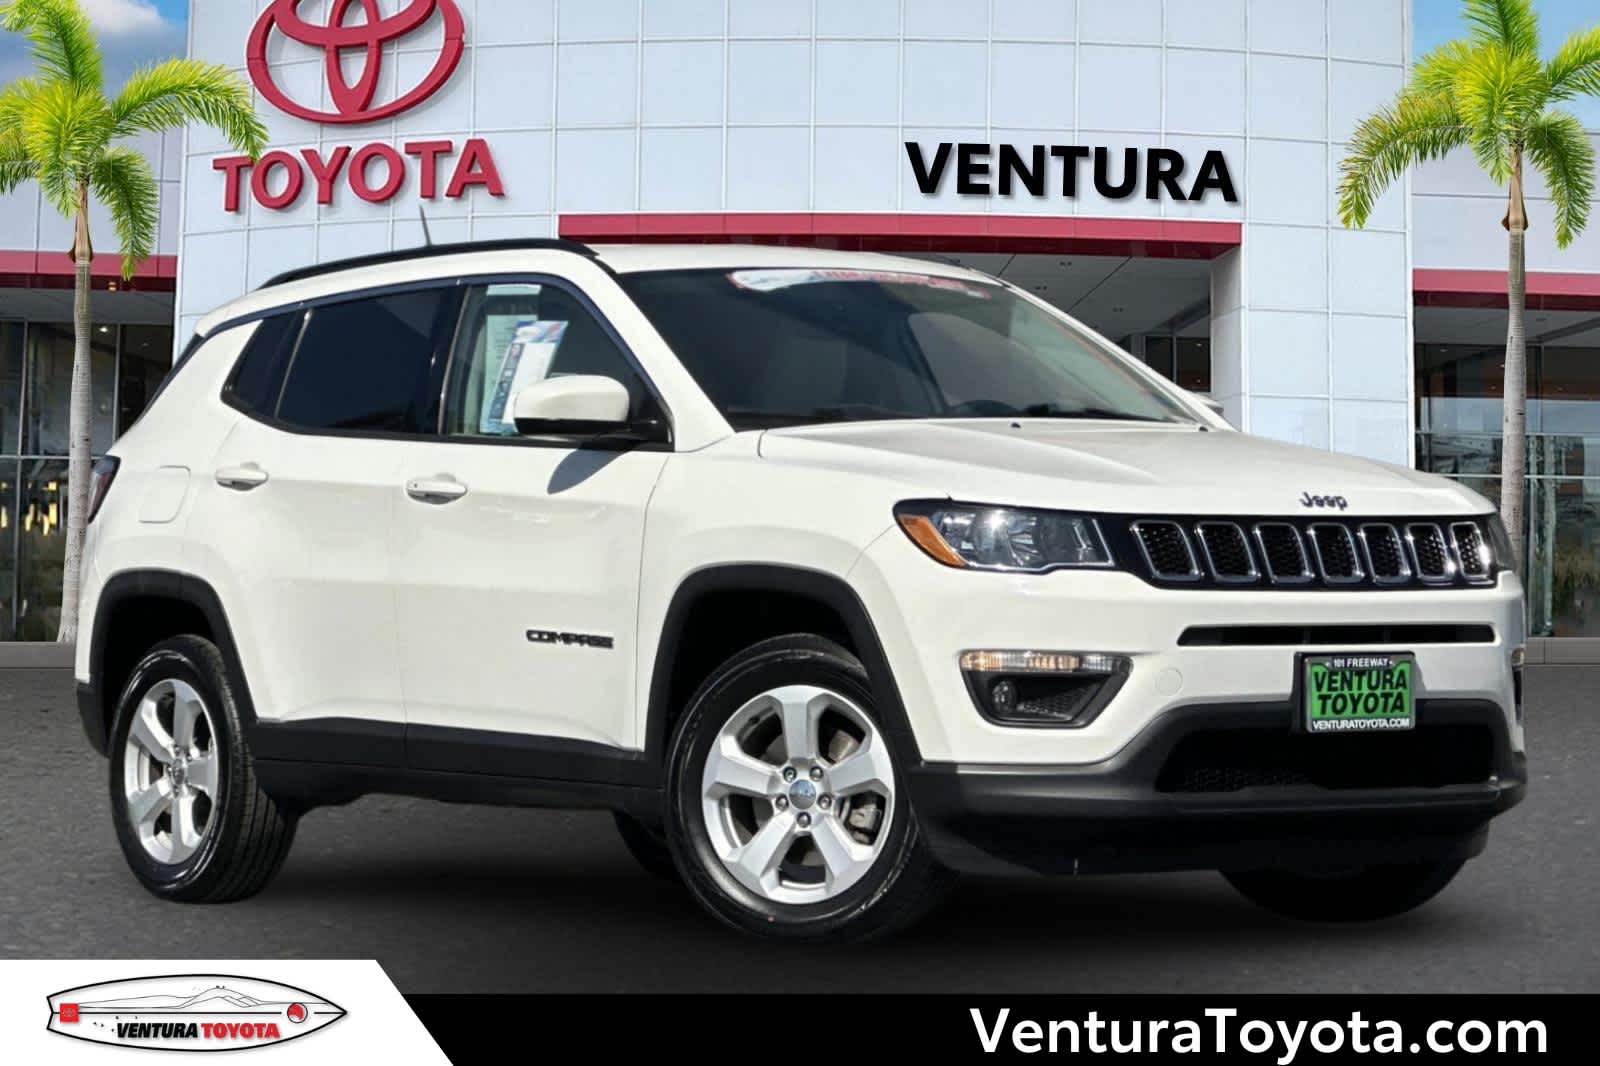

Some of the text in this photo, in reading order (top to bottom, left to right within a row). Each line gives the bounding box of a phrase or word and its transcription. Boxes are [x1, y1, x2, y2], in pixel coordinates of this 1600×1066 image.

[212, 138, 506, 213] TOYOTA
[904, 141, 1240, 203] VENTURA
[1299, 491, 1348, 511] Jeep
[526, 629, 614, 649] COMPASS
[1347, 657, 1389, 668] FREEWAY
[1314, 669, 1408, 692] VENTURA
[1318, 692, 1405, 716] TOYOTA
[1312, 718, 1410, 730] VENTURATOYOTA.COM
